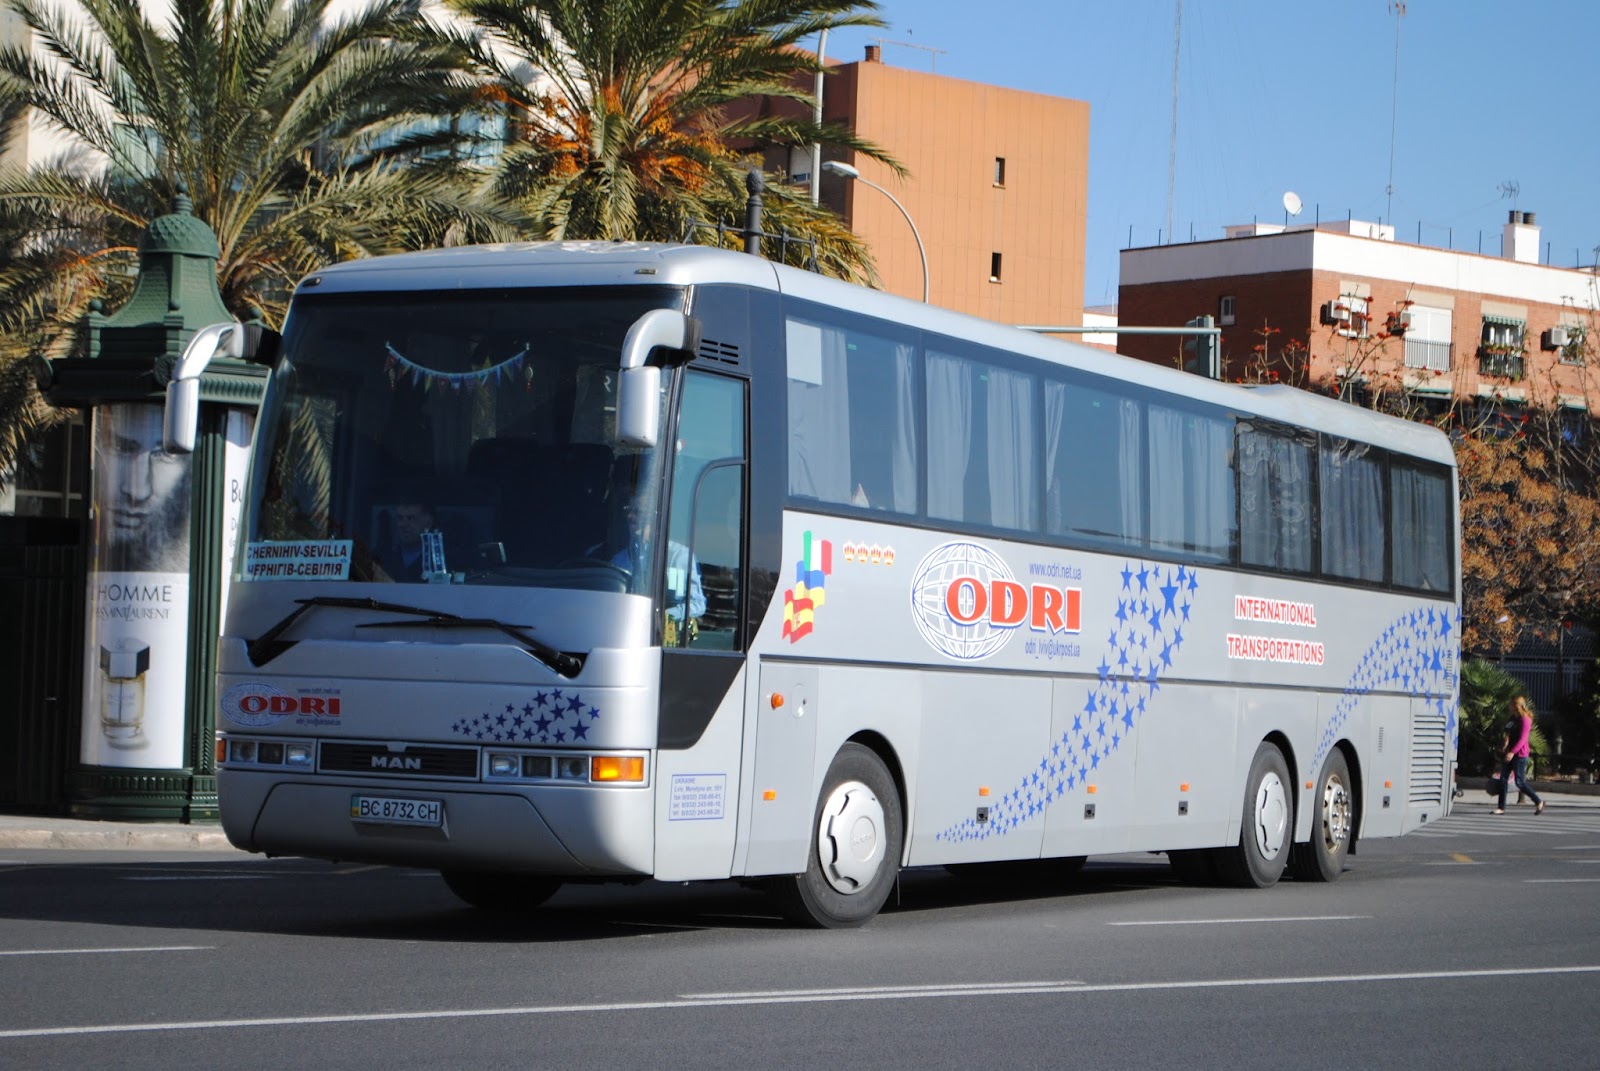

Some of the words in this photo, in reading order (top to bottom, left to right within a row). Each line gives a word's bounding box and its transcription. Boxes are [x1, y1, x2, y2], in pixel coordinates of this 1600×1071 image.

[247, 545, 347, 559] CHERNIHIV-SEVILLA
[1029, 562, 1082, 580] www.odri.net.ua
[945, 576, 1082, 633] ODRI
[1235, 597, 1316, 626] INTERNATIONAL
[1227, 636, 1324, 664] TRANSPORTATIONS
[240, 696, 341, 716] ODRI
[371, 756, 422, 770] MAN
[360, 800, 380, 816] BC
[383, 802, 415, 819] 8732
[418, 804, 438, 820] CH
